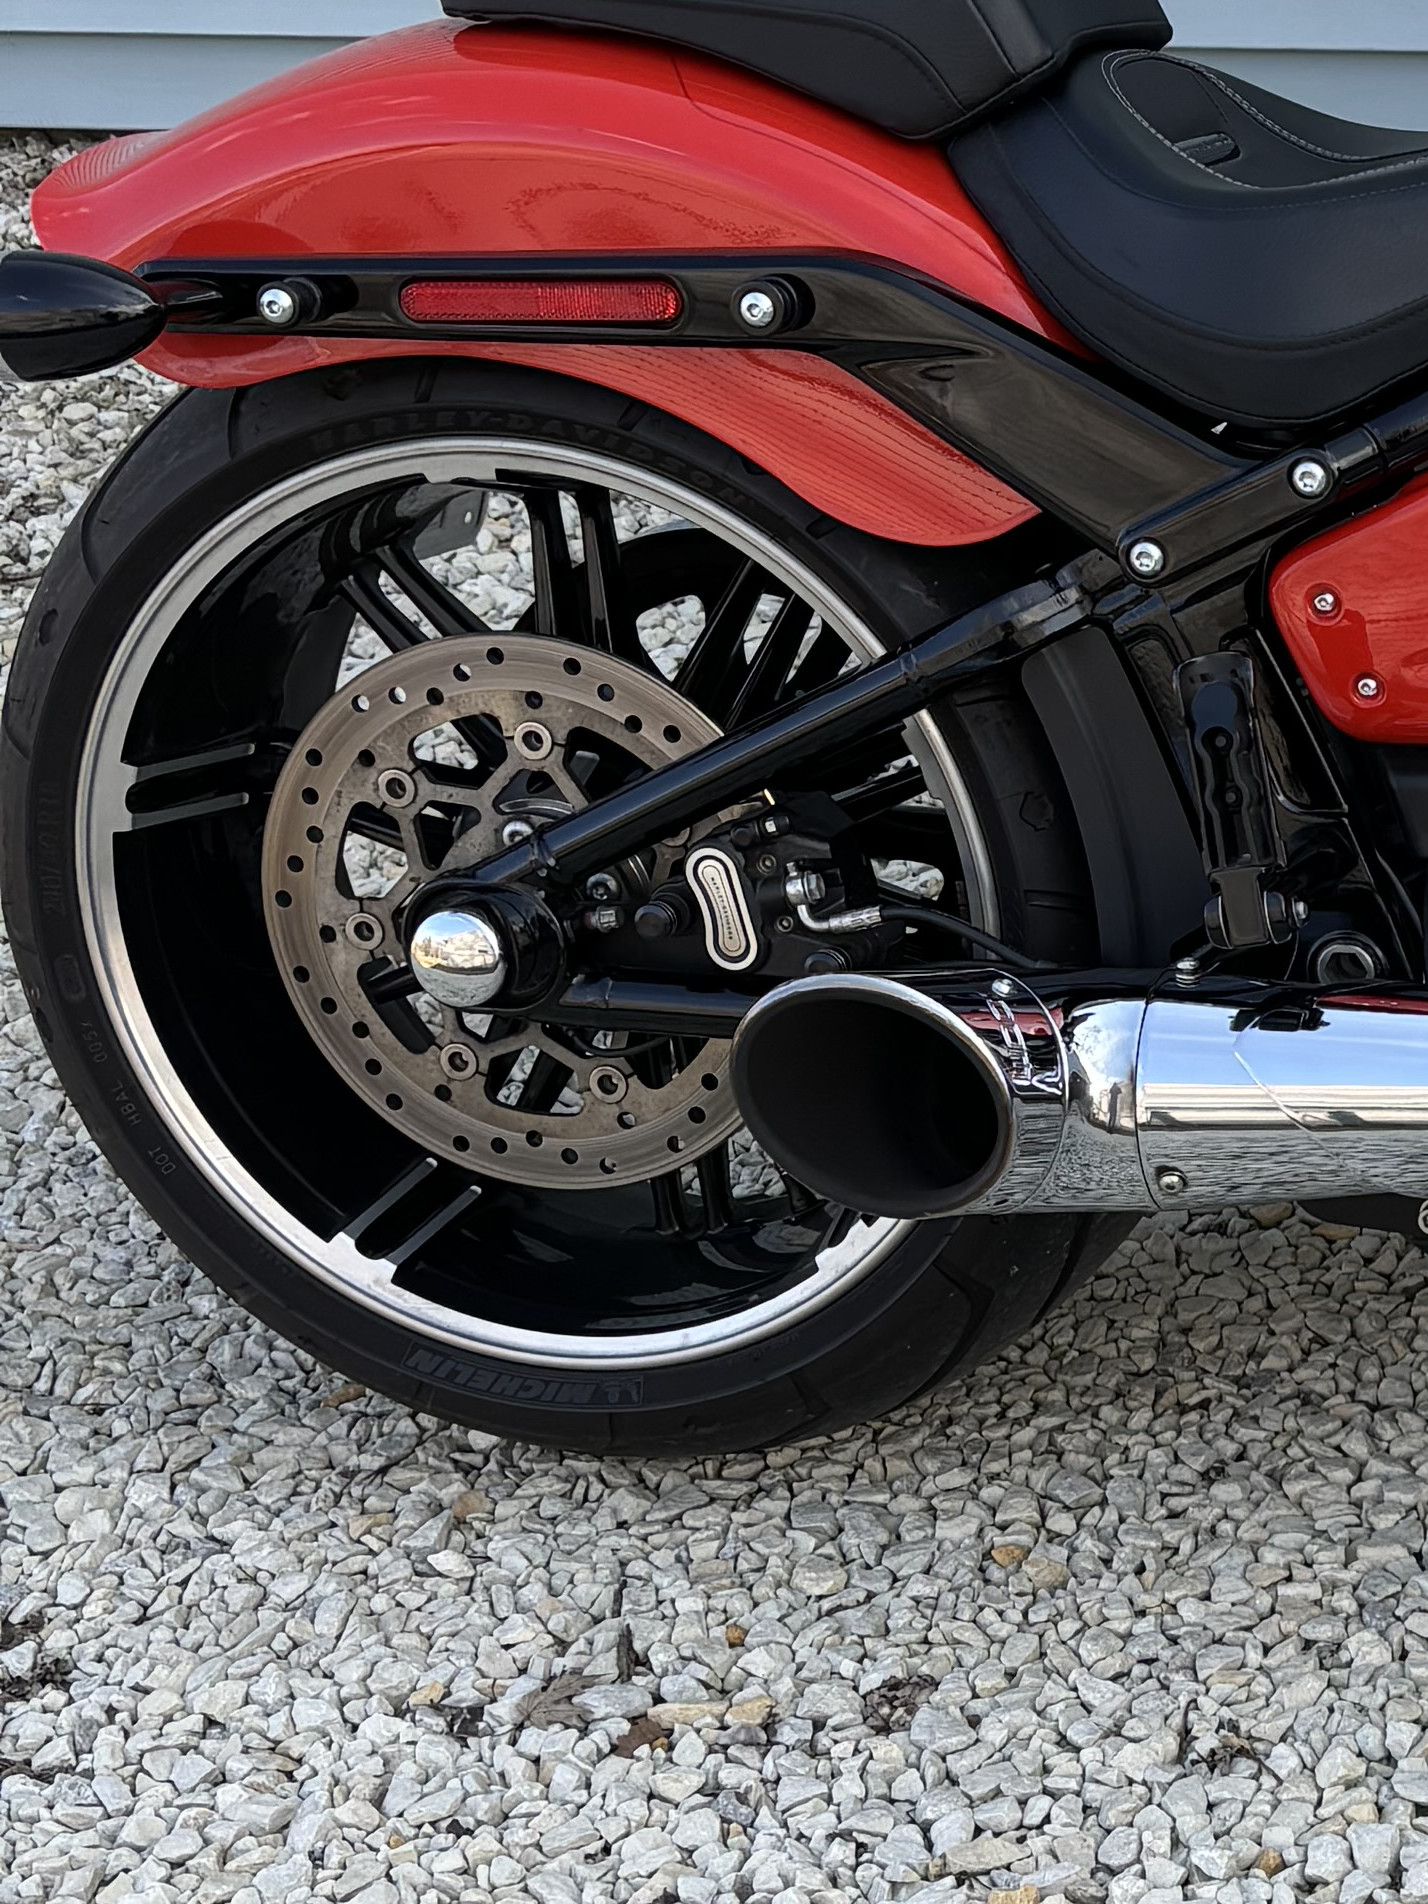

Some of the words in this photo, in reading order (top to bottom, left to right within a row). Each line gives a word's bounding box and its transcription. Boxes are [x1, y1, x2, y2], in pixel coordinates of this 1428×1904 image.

[308, 407, 756, 511] HARLEY-DAVIDSON
[110, 1082, 142, 1128] HBAL
[147, 1145, 177, 1177] DOT
[404, 1348, 597, 1404] MICHELIN
